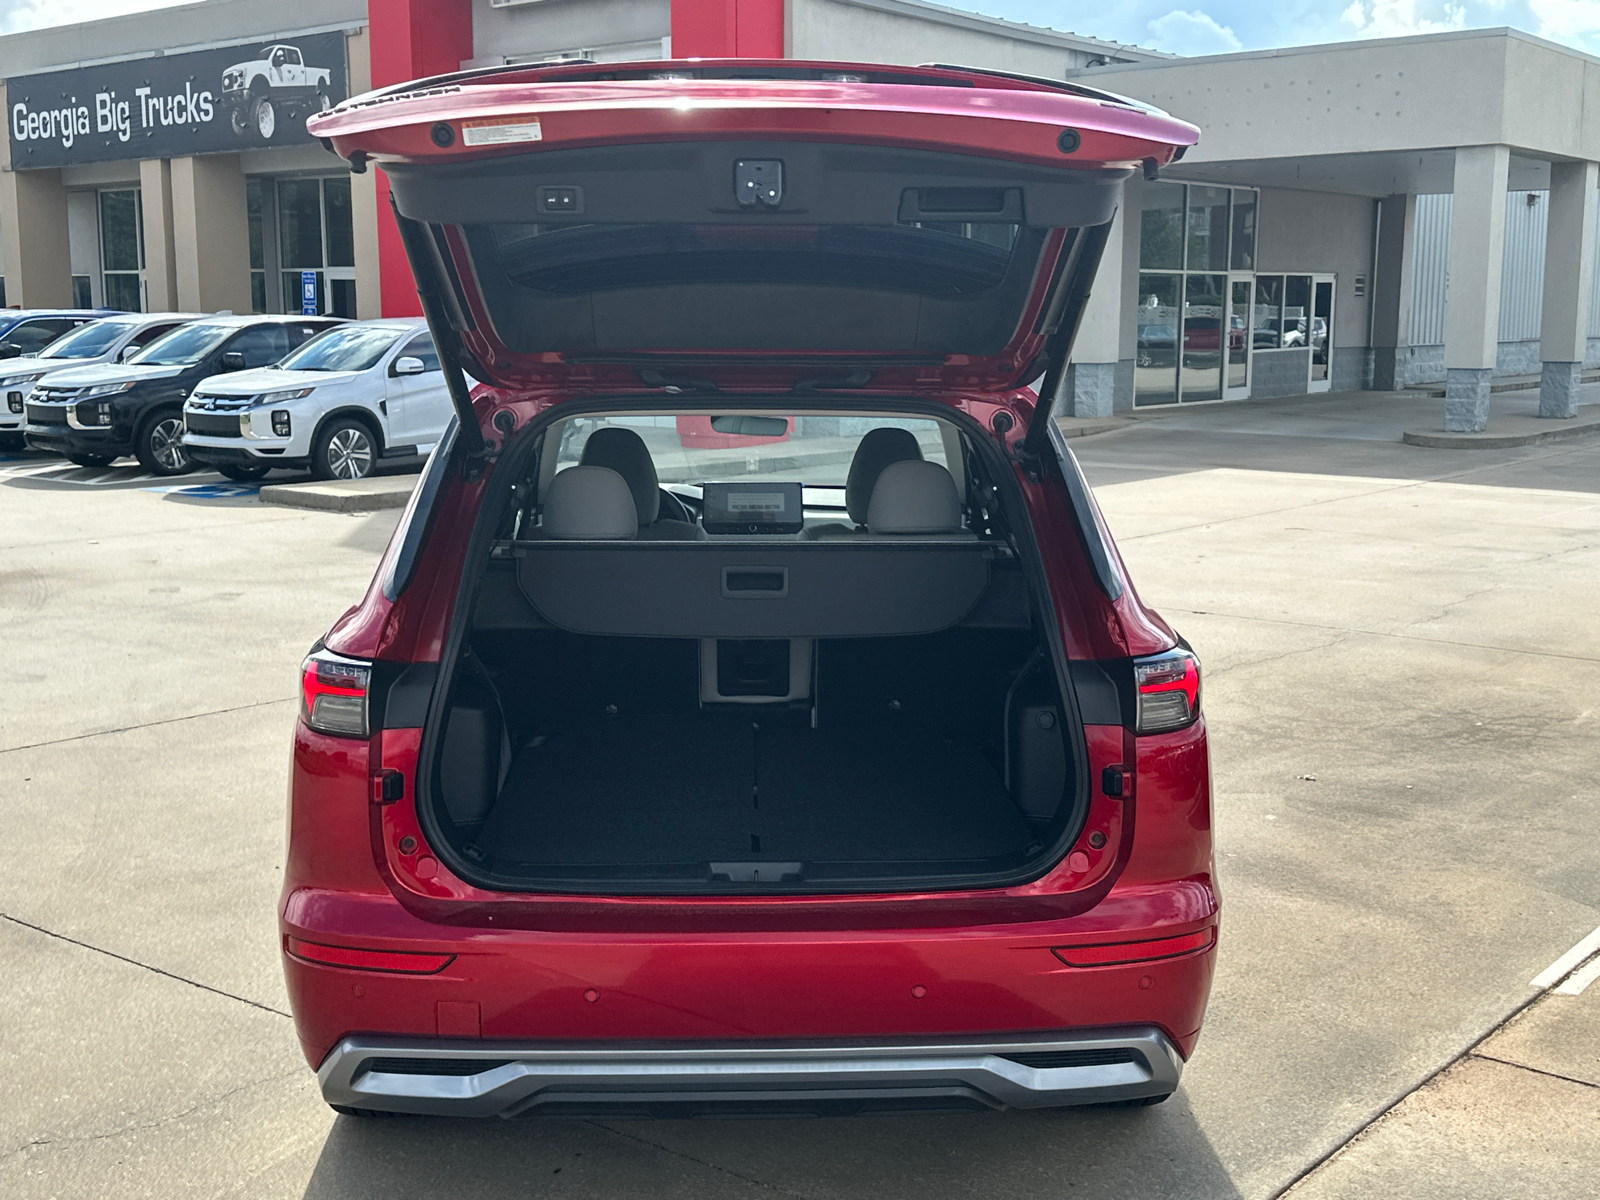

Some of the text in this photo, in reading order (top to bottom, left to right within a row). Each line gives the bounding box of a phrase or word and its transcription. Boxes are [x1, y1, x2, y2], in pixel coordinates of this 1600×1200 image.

[13, 81, 214, 148] Georgia Big Trucks
